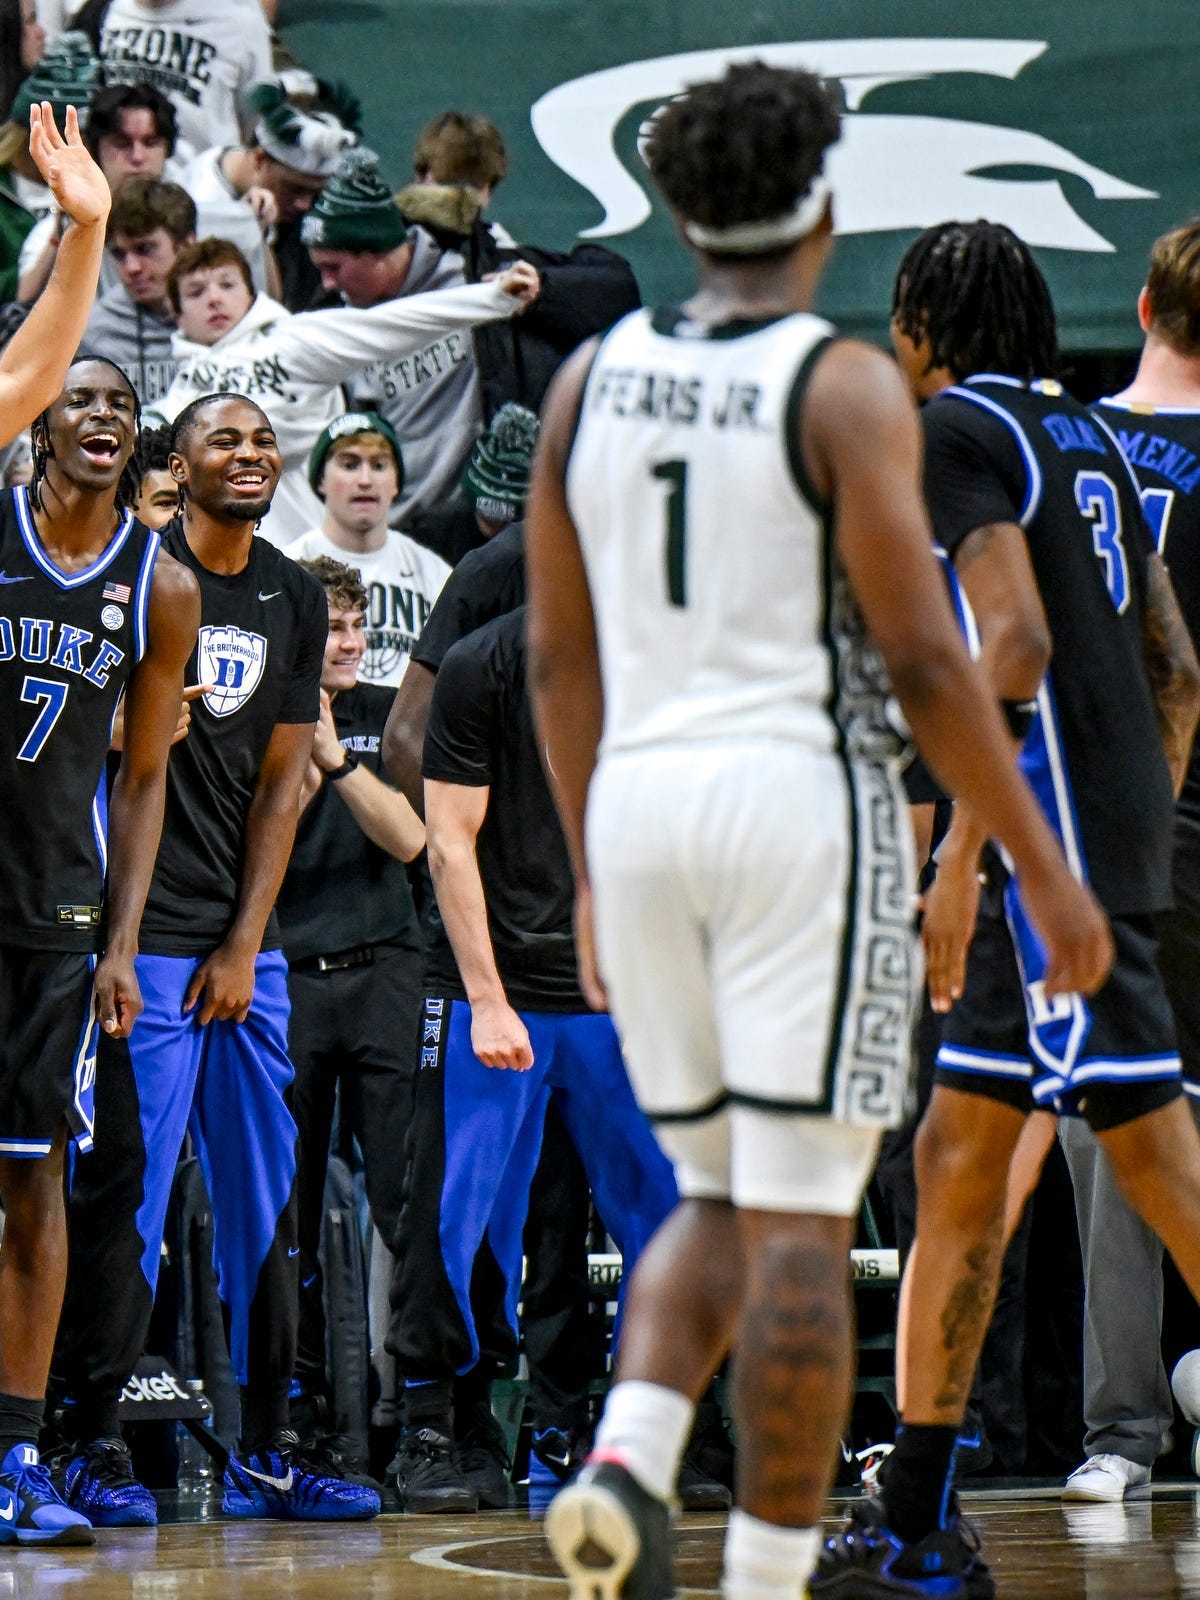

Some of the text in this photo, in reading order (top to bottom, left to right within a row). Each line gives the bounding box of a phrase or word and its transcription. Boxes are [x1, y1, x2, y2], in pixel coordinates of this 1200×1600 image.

[595, 369, 704, 426] FEARS
[650, 459, 687, 609] 1
[1074, 469, 1131, 616] 3
[203, 643, 260, 662] THE BROTHERHOOD
[16, 675, 69, 763] 7
[118, 1371, 190, 1402] cket
